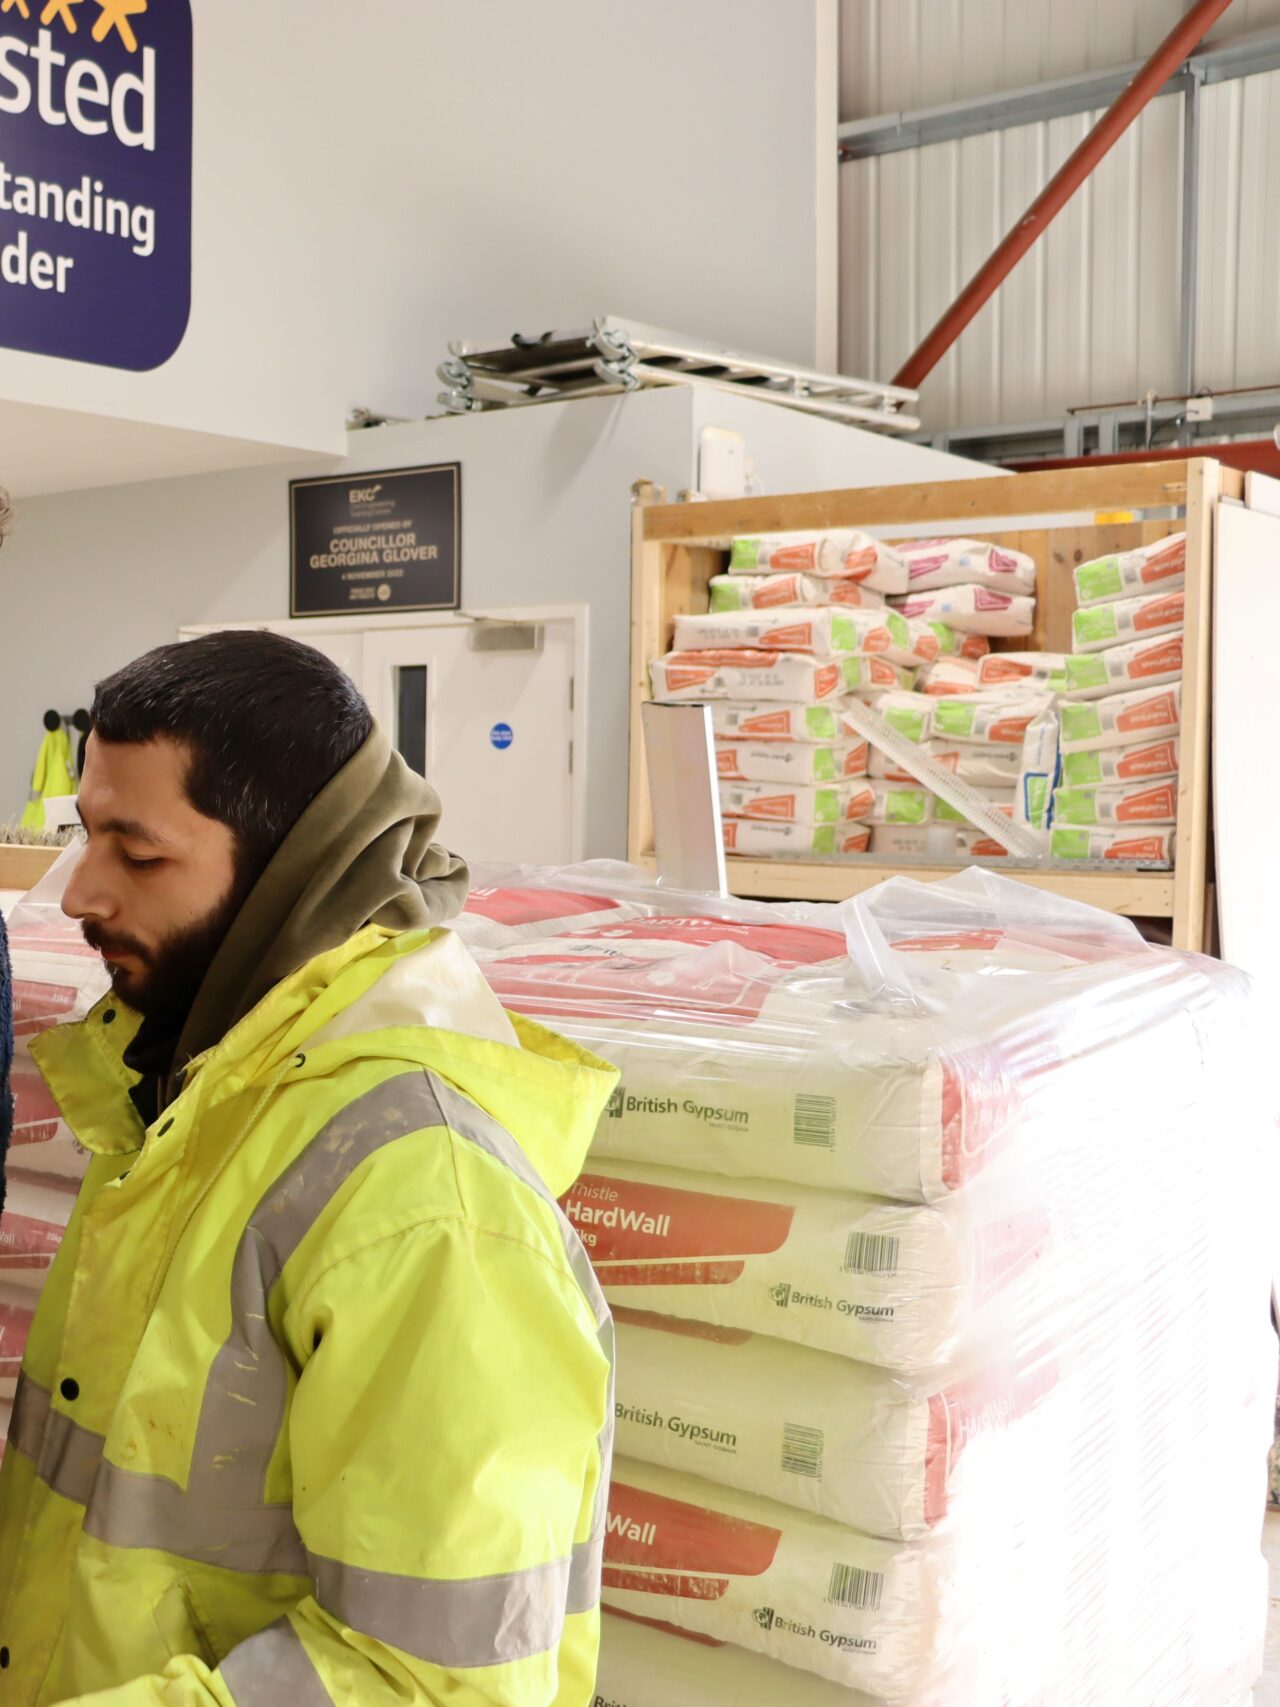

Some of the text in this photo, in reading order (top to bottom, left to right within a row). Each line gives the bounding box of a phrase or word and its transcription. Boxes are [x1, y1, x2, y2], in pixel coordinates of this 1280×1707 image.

[330, 532, 416, 553] COUNCILLOR
[310, 545, 438, 569] GEORGINA GLOVER
[626, 1096, 749, 1123] British Gypsum
[572, 1182, 618, 1201] Thistle
[565, 1199, 671, 1237] HardWall
[791, 1291, 894, 1317] British Gypsum
[615, 1402, 737, 1446] British Gypsum
[774, 1616, 877, 1649] British Gypsum
